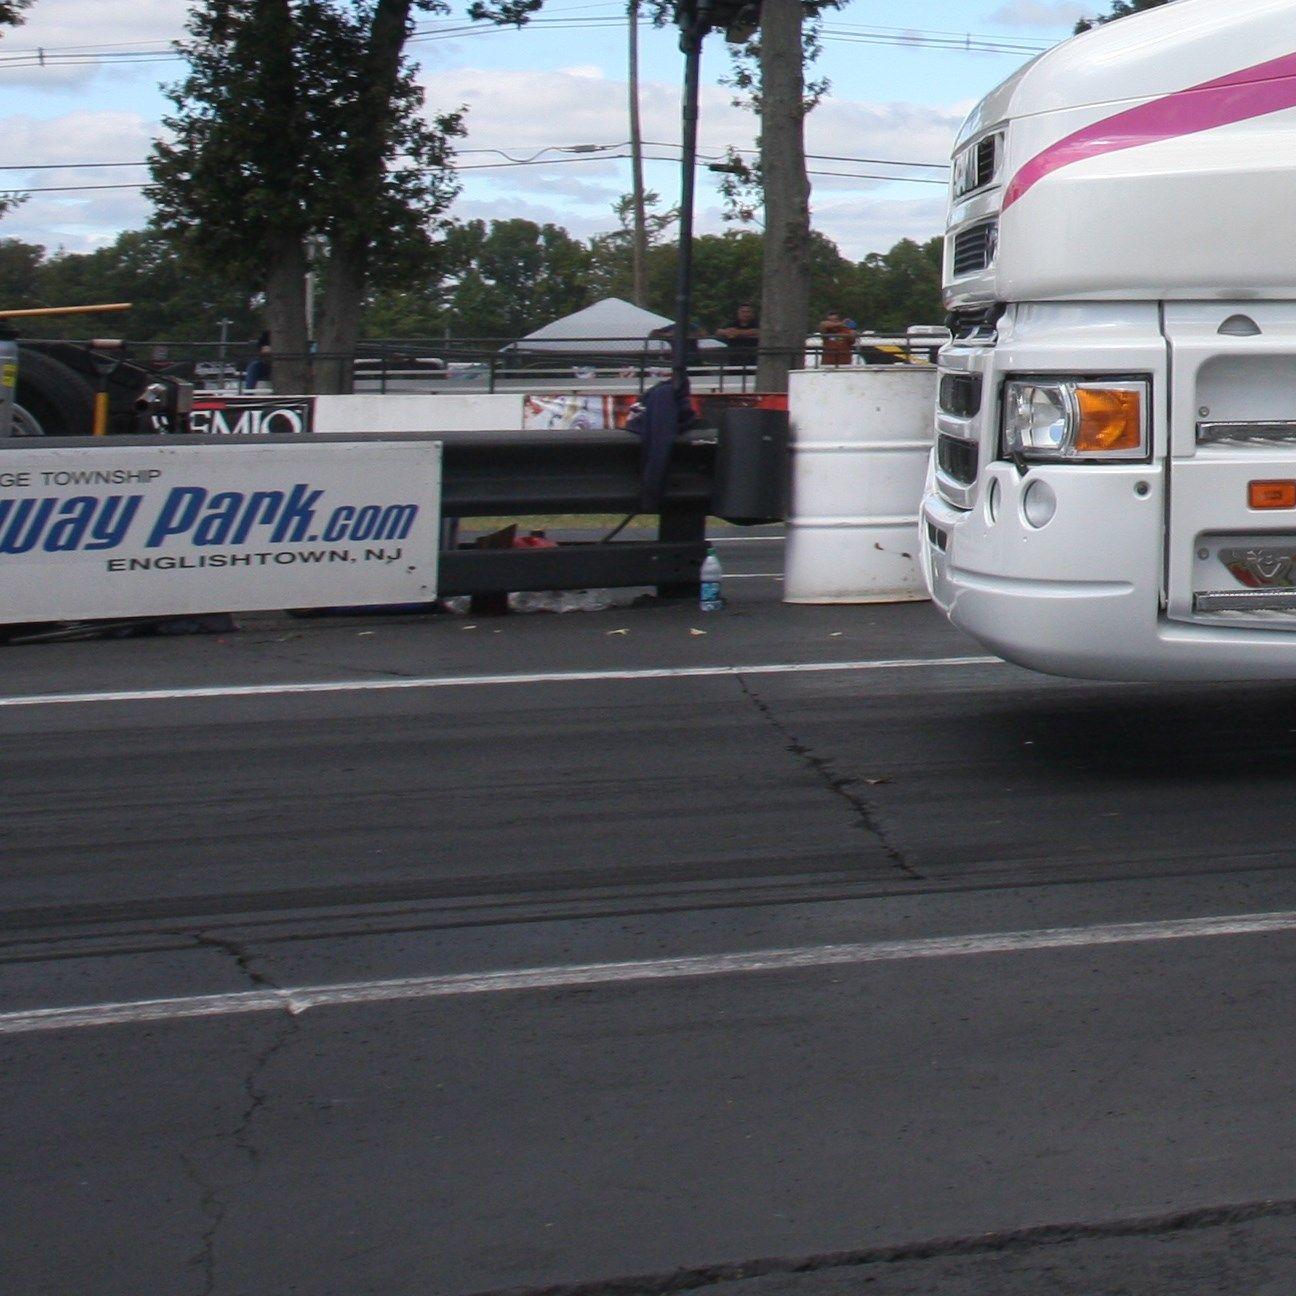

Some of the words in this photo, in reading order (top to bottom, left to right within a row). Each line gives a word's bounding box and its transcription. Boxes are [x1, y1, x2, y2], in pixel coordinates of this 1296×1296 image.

[41, 468, 162, 486] TOWNSHIP
[145, 483, 419, 549] Park.com
[106, 549, 356, 572] ENGLISHTOWN,
[364, 548, 402, 562] NJ
